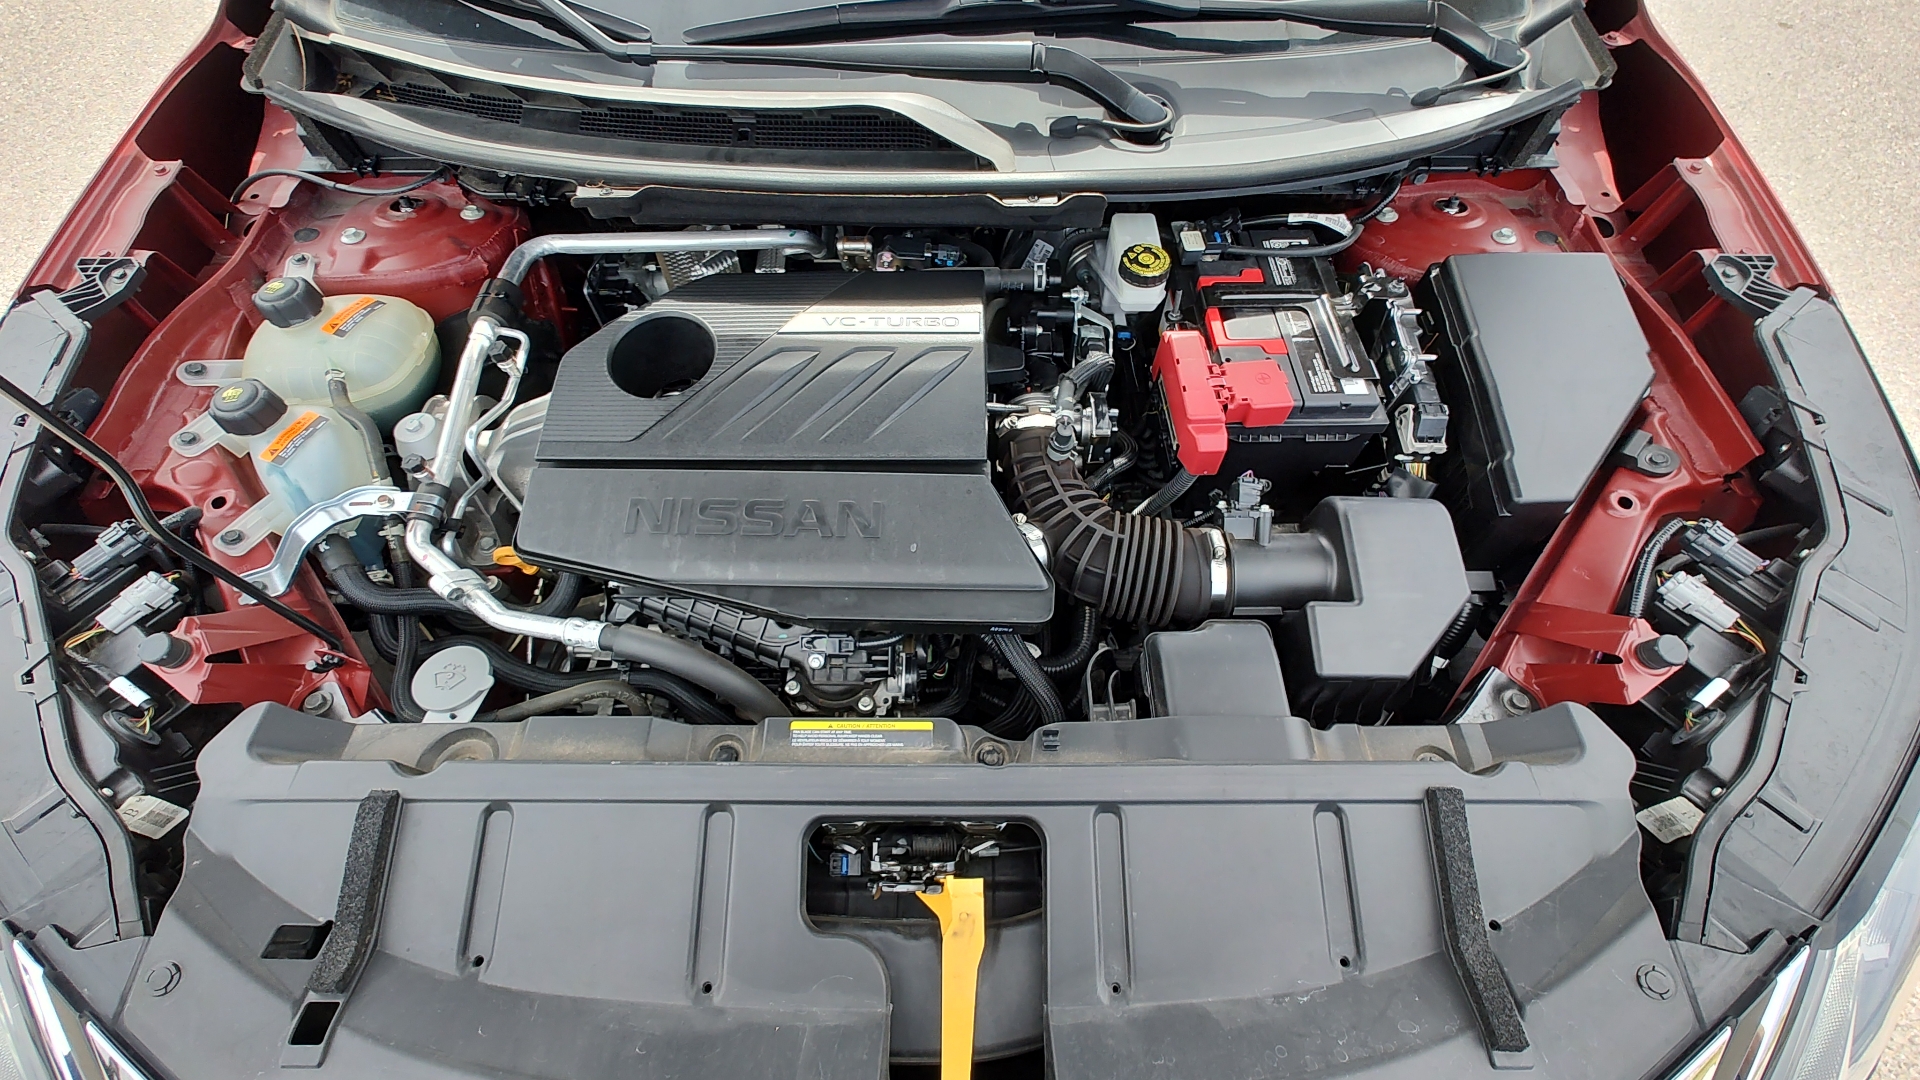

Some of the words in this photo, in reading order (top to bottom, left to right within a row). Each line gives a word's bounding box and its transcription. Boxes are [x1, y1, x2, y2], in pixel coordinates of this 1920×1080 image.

[821, 316, 960, 327] VC-TURBO
[275, 426, 296, 445] WARNING
[623, 497, 883, 538] NISSAN
